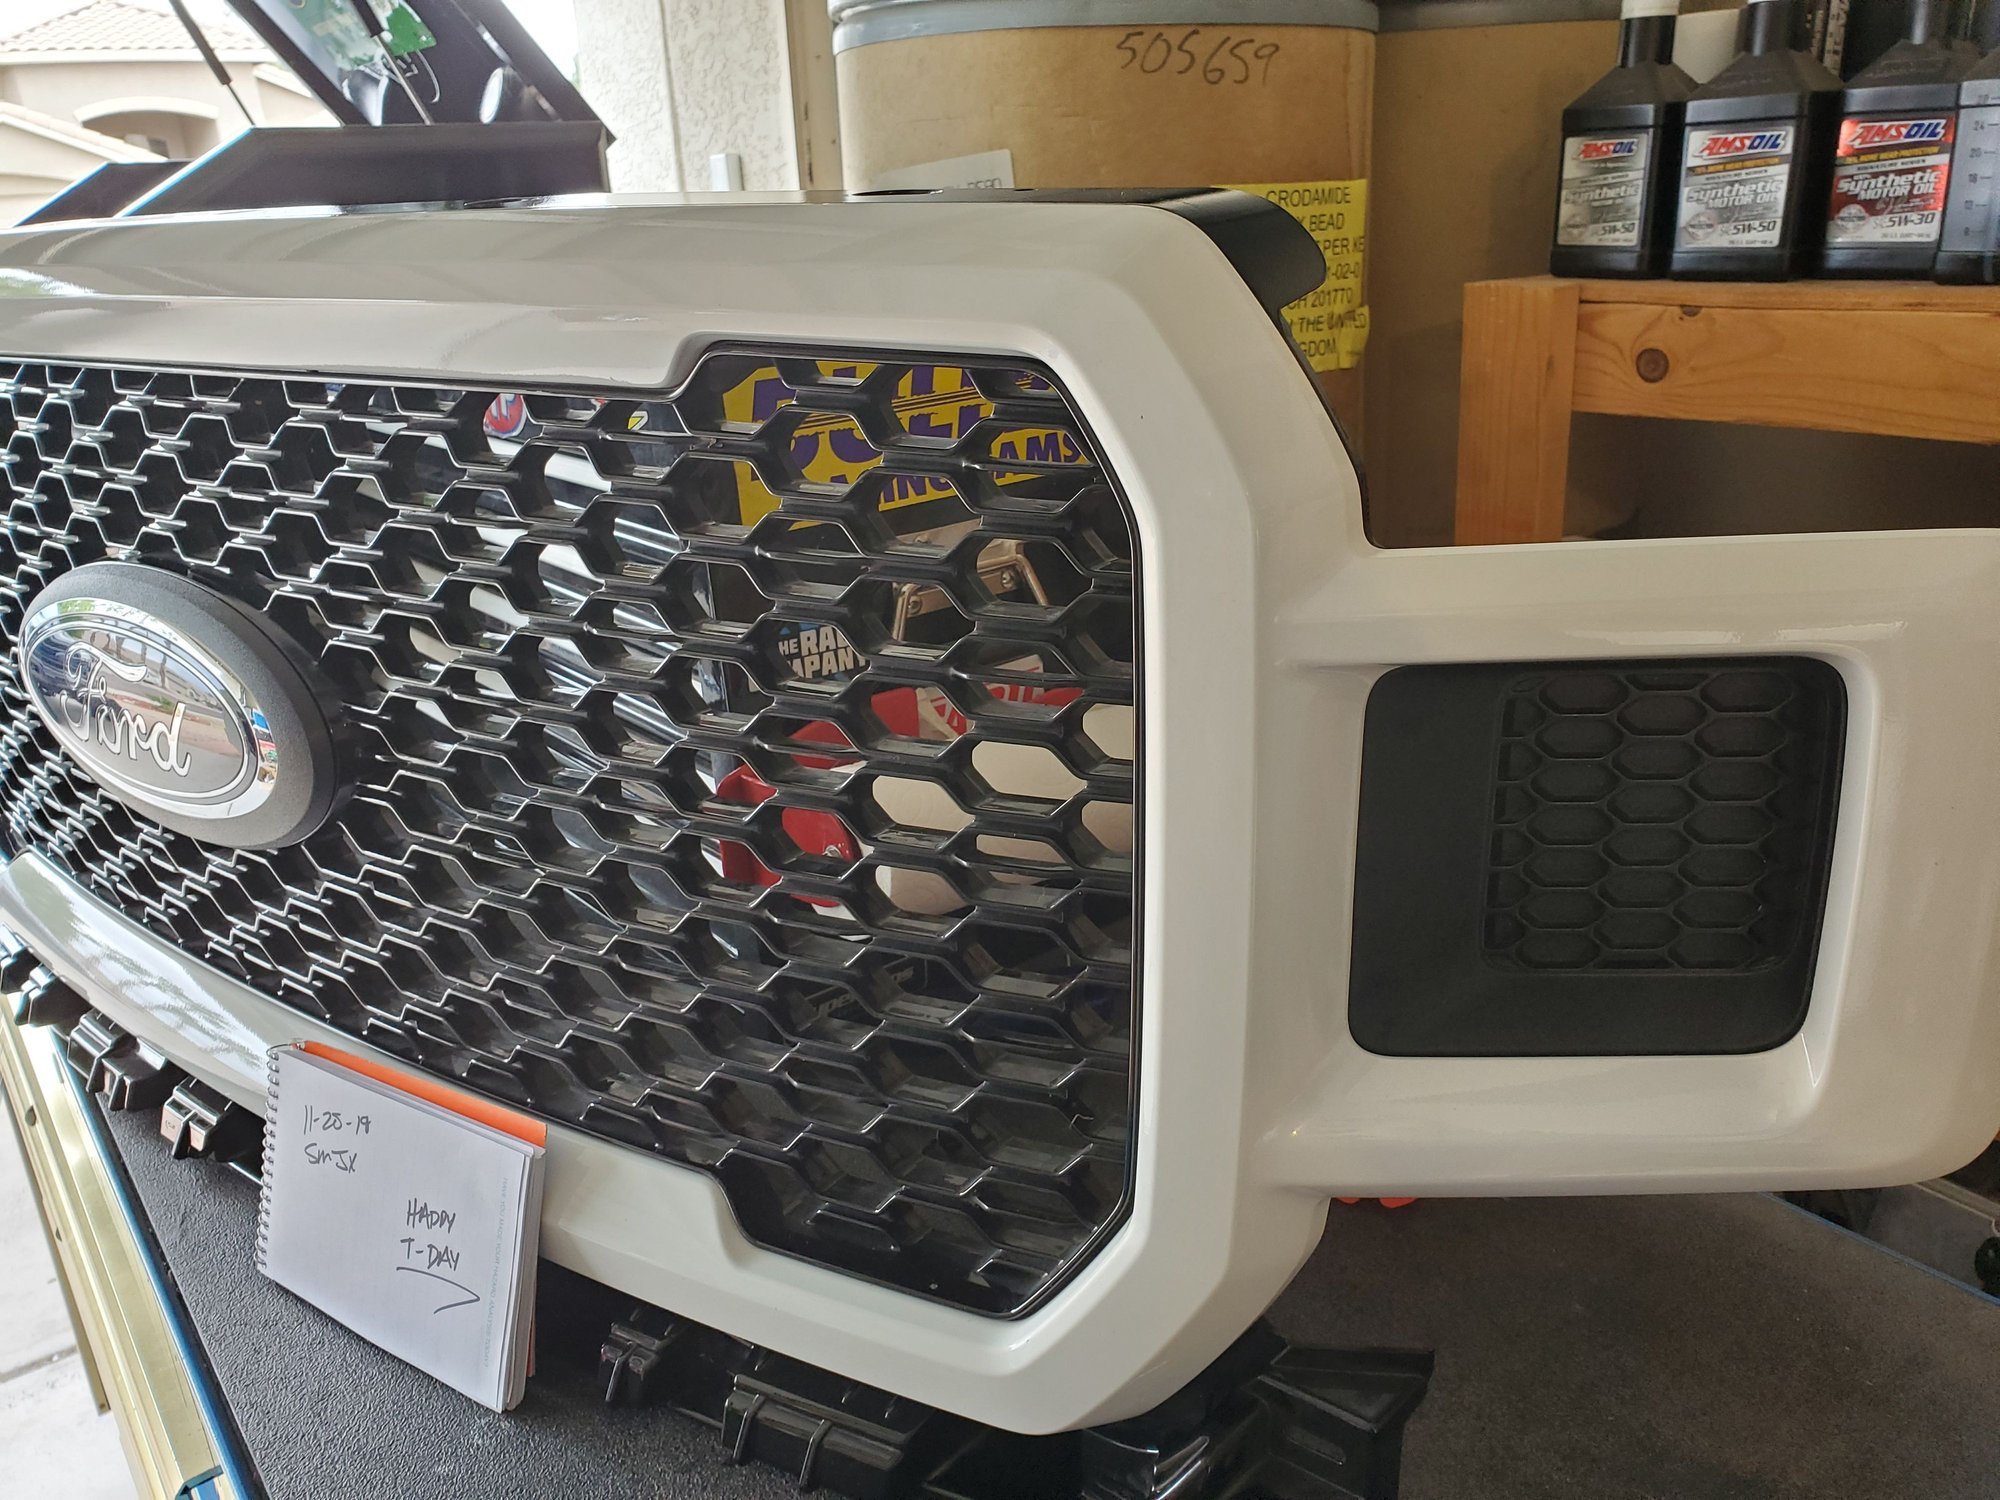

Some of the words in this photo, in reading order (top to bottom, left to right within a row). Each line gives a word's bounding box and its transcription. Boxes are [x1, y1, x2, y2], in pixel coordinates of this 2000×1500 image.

[1114, 28, 1280, 87] 505659
[1699, 133, 1782, 157] AMSOIL
[1849, 121, 1943, 147] AMSOIL
[1579, 140, 1635, 159] AMSOIL
[1686, 179, 1784, 204] Synthetic
[1836, 168, 1942, 195] Synthetic
[1857, 184, 1911, 201] MOTOR
[1912, 181, 1938, 195] OIL
[1707, 193, 1753, 209] MOTOR
[1309, 213, 1345, 232] BEAD
[1324, 238, 1350, 255] PER
[1300, 316, 1325, 333] THE
[778, 638, 799, 656] HE
[60, 642, 192, 777] Ford
[400, 1237, 460, 1271] T-DAY
